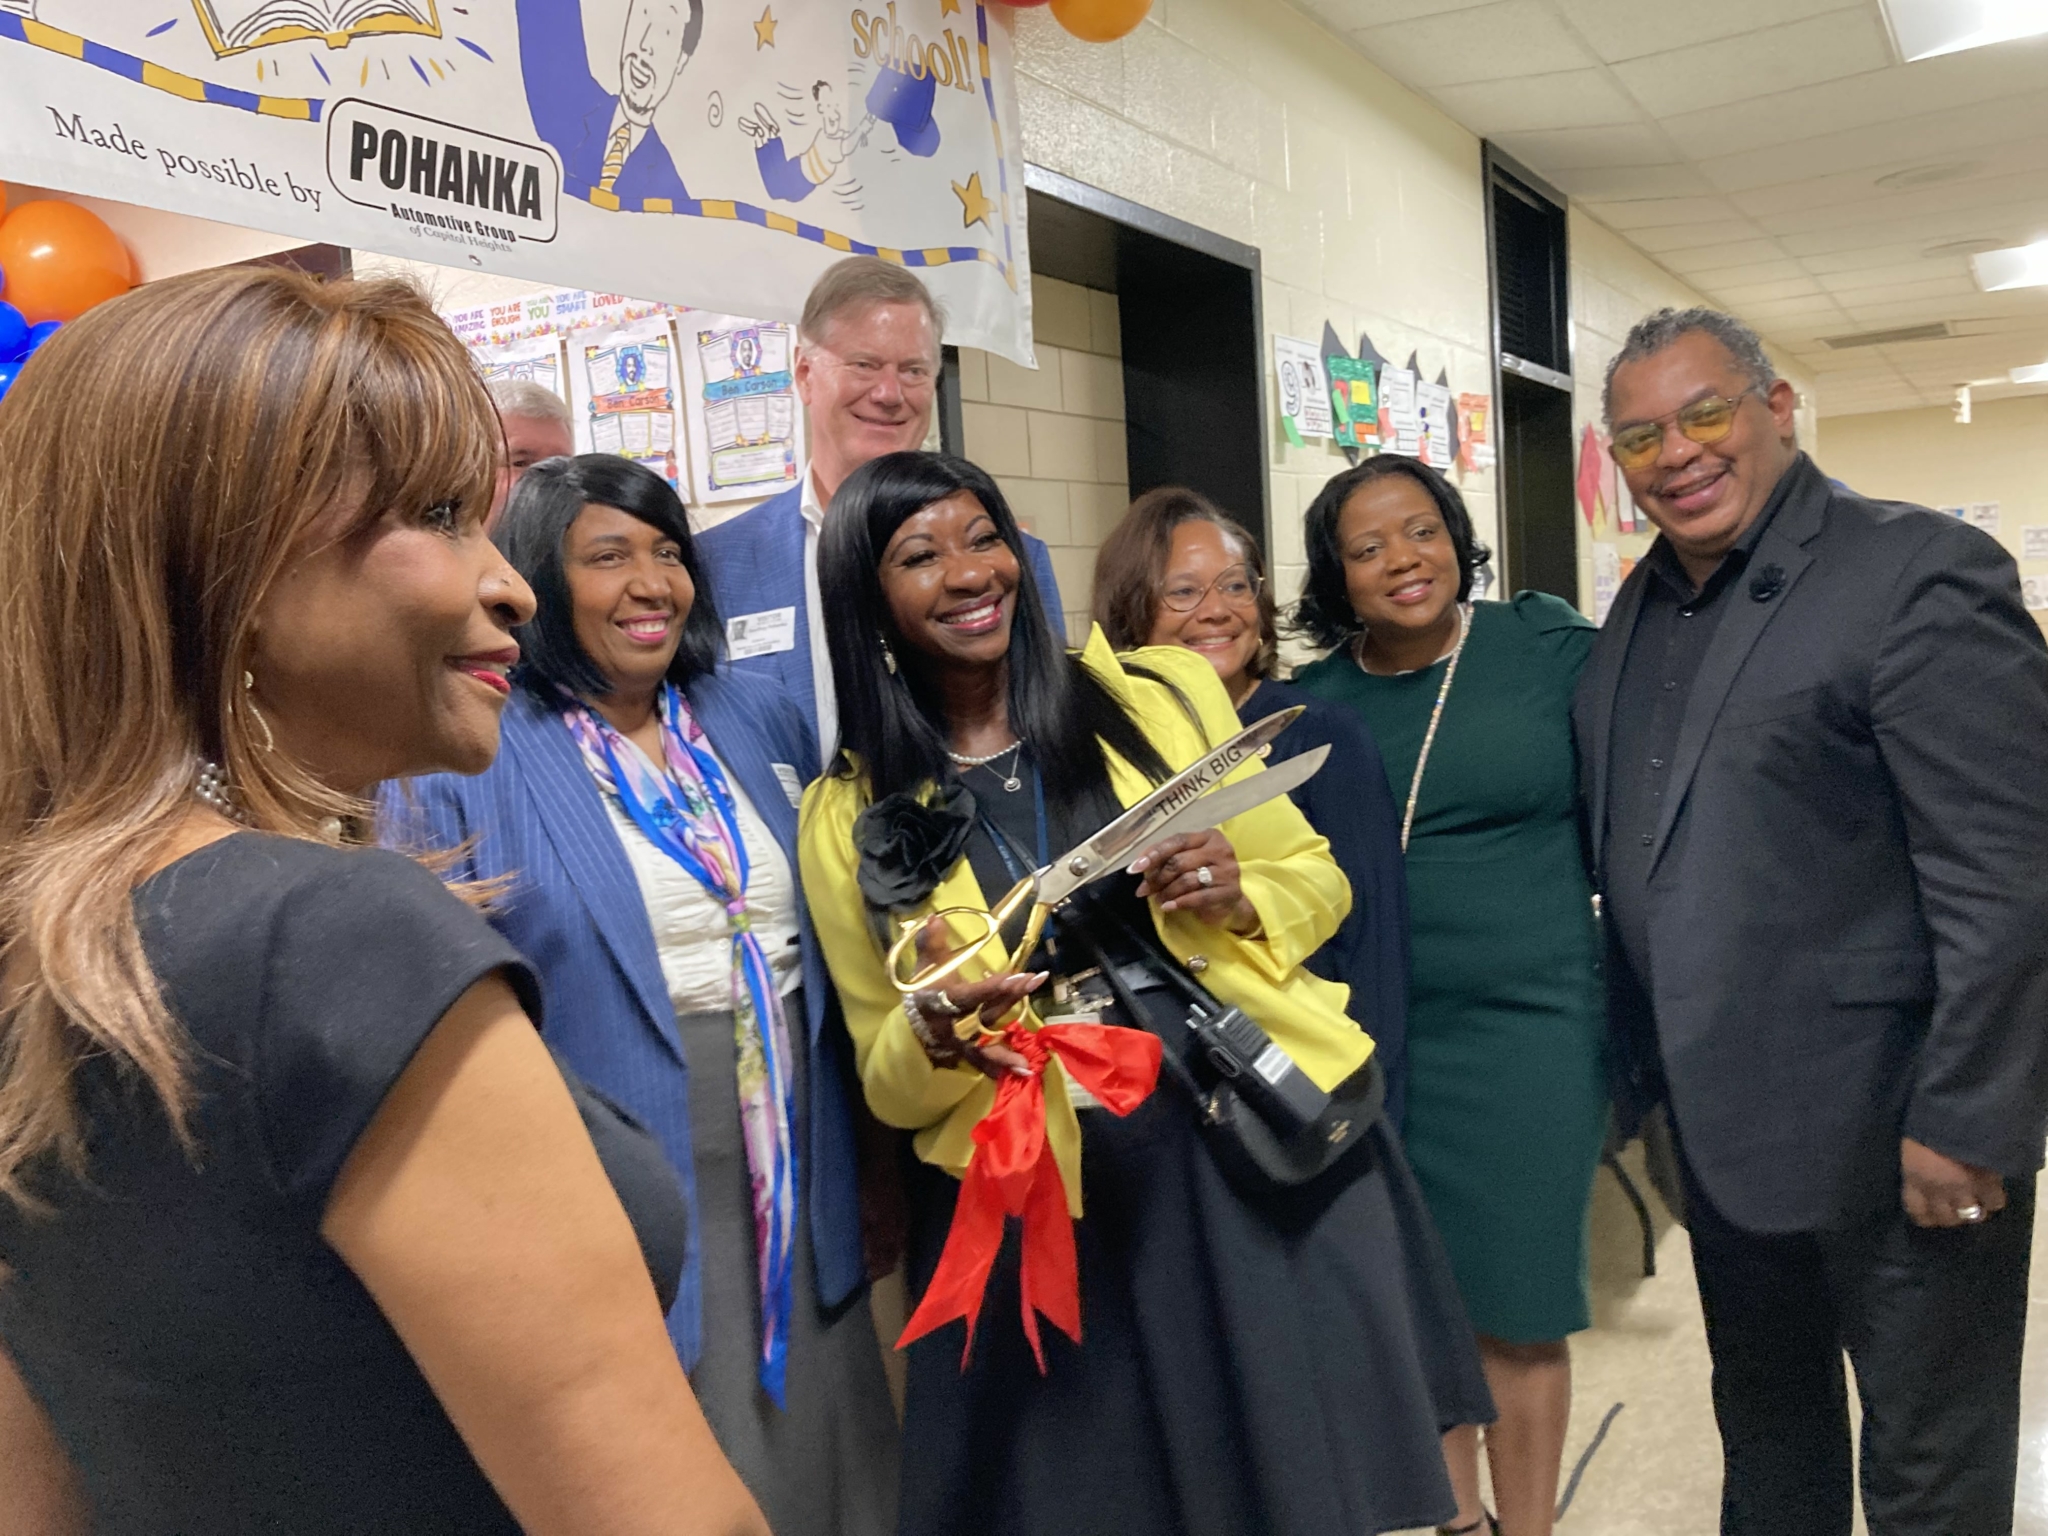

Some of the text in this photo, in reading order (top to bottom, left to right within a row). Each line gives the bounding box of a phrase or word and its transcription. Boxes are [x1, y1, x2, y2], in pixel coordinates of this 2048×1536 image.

[851, 1, 975, 94] school!
[46, 106, 321, 213] Made possible by
[350, 120, 542, 221] POHANKA
[391, 203, 517, 243] Automotive Group
[409, 225, 513, 252] of Capitol Heights
[490, 306, 506, 316] YOU
[527, 304, 549, 320] YOU
[593, 294, 624, 308] LOVED
